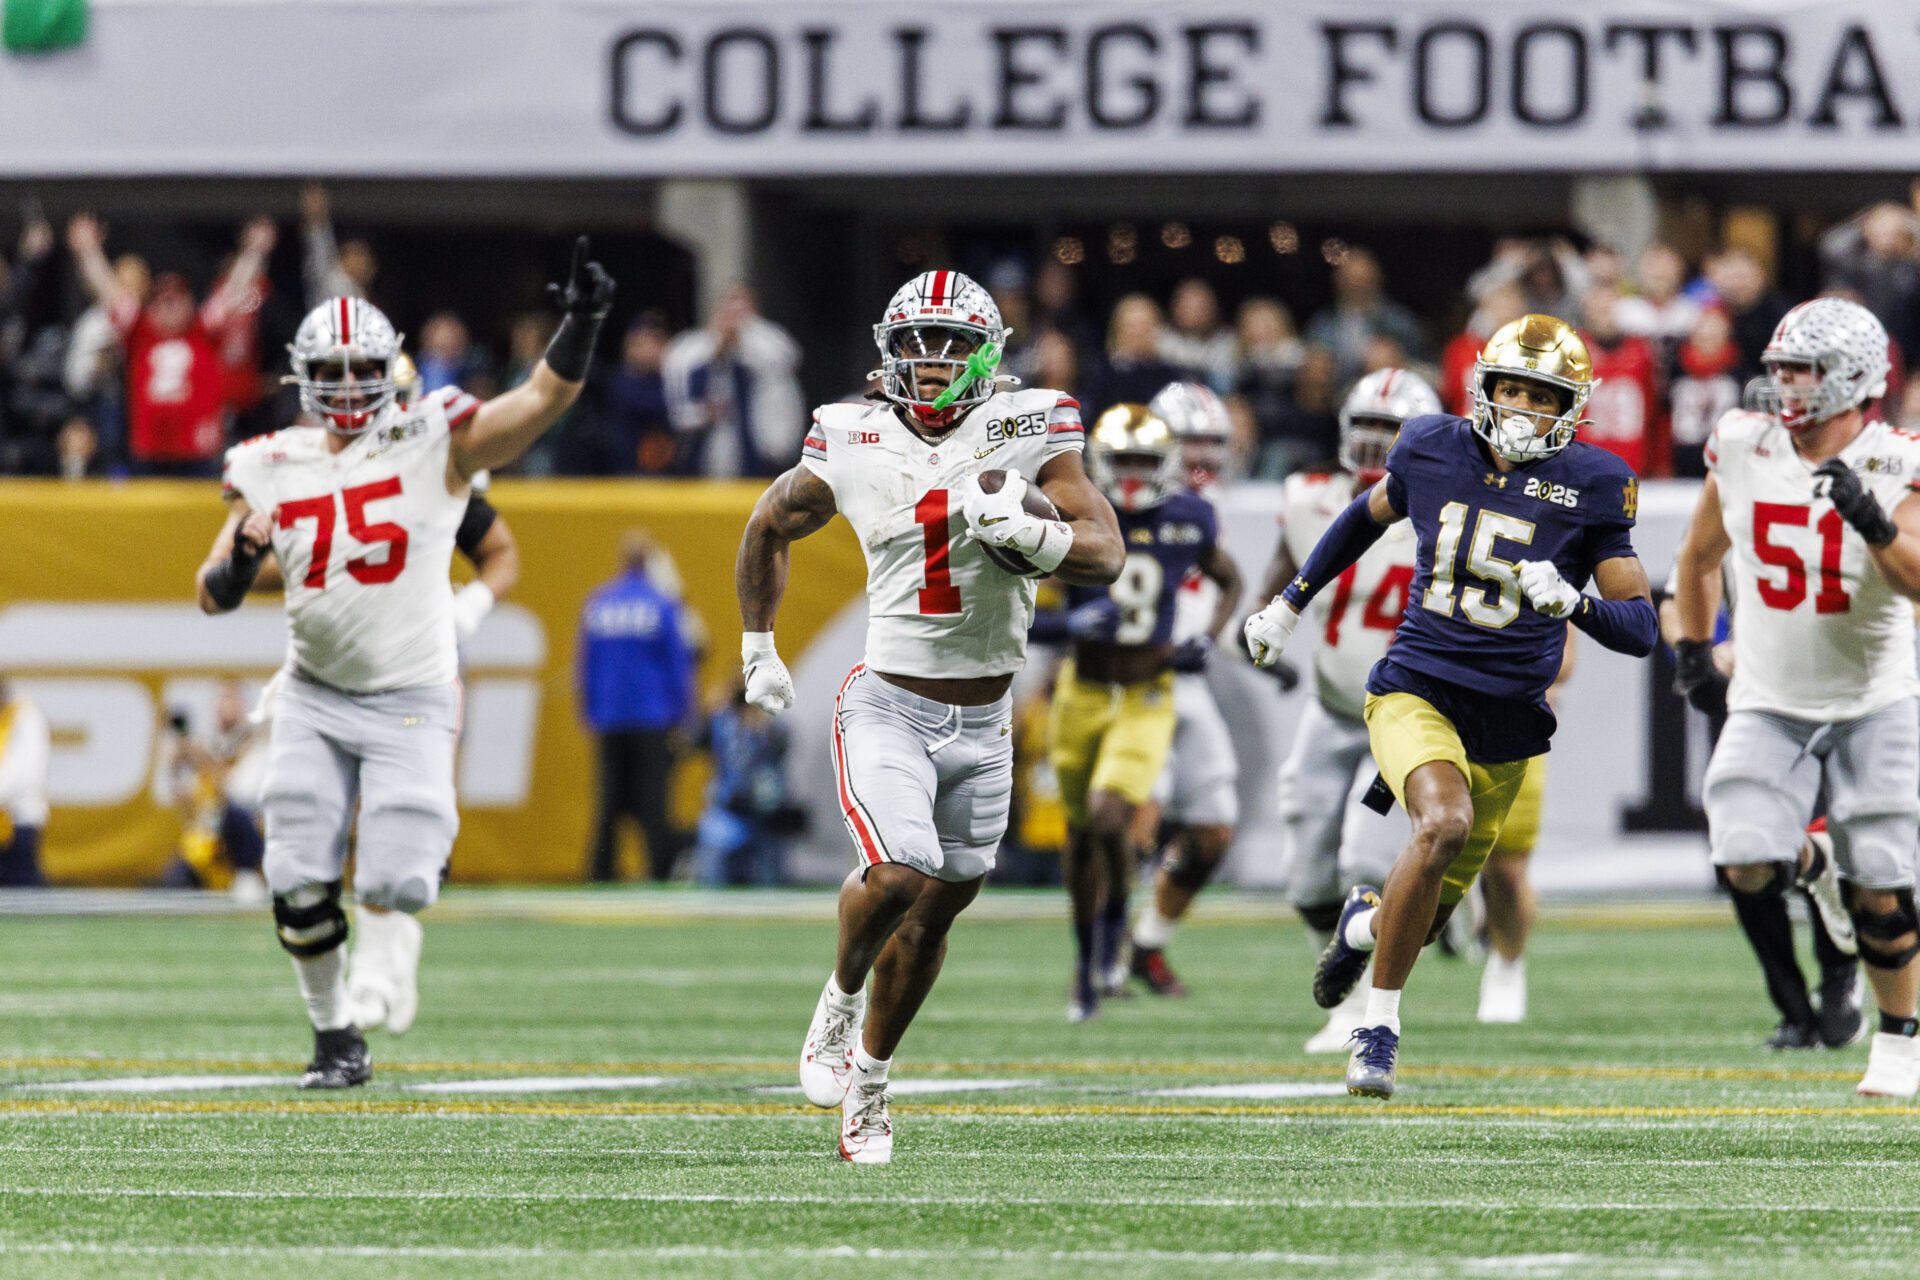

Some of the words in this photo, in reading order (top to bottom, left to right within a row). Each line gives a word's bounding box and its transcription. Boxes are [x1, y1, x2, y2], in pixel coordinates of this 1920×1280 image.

[608, 20, 1261, 138] COLLEGE
[1317, 18, 1920, 134] FOOTBA
[987, 413, 1047, 441] 2025
[278, 476, 408, 589] 75
[1523, 477, 1579, 508] 2025
[915, 488, 963, 615] 1
[1422, 501, 1537, 629] 15
[1753, 502, 1850, 615] 51
